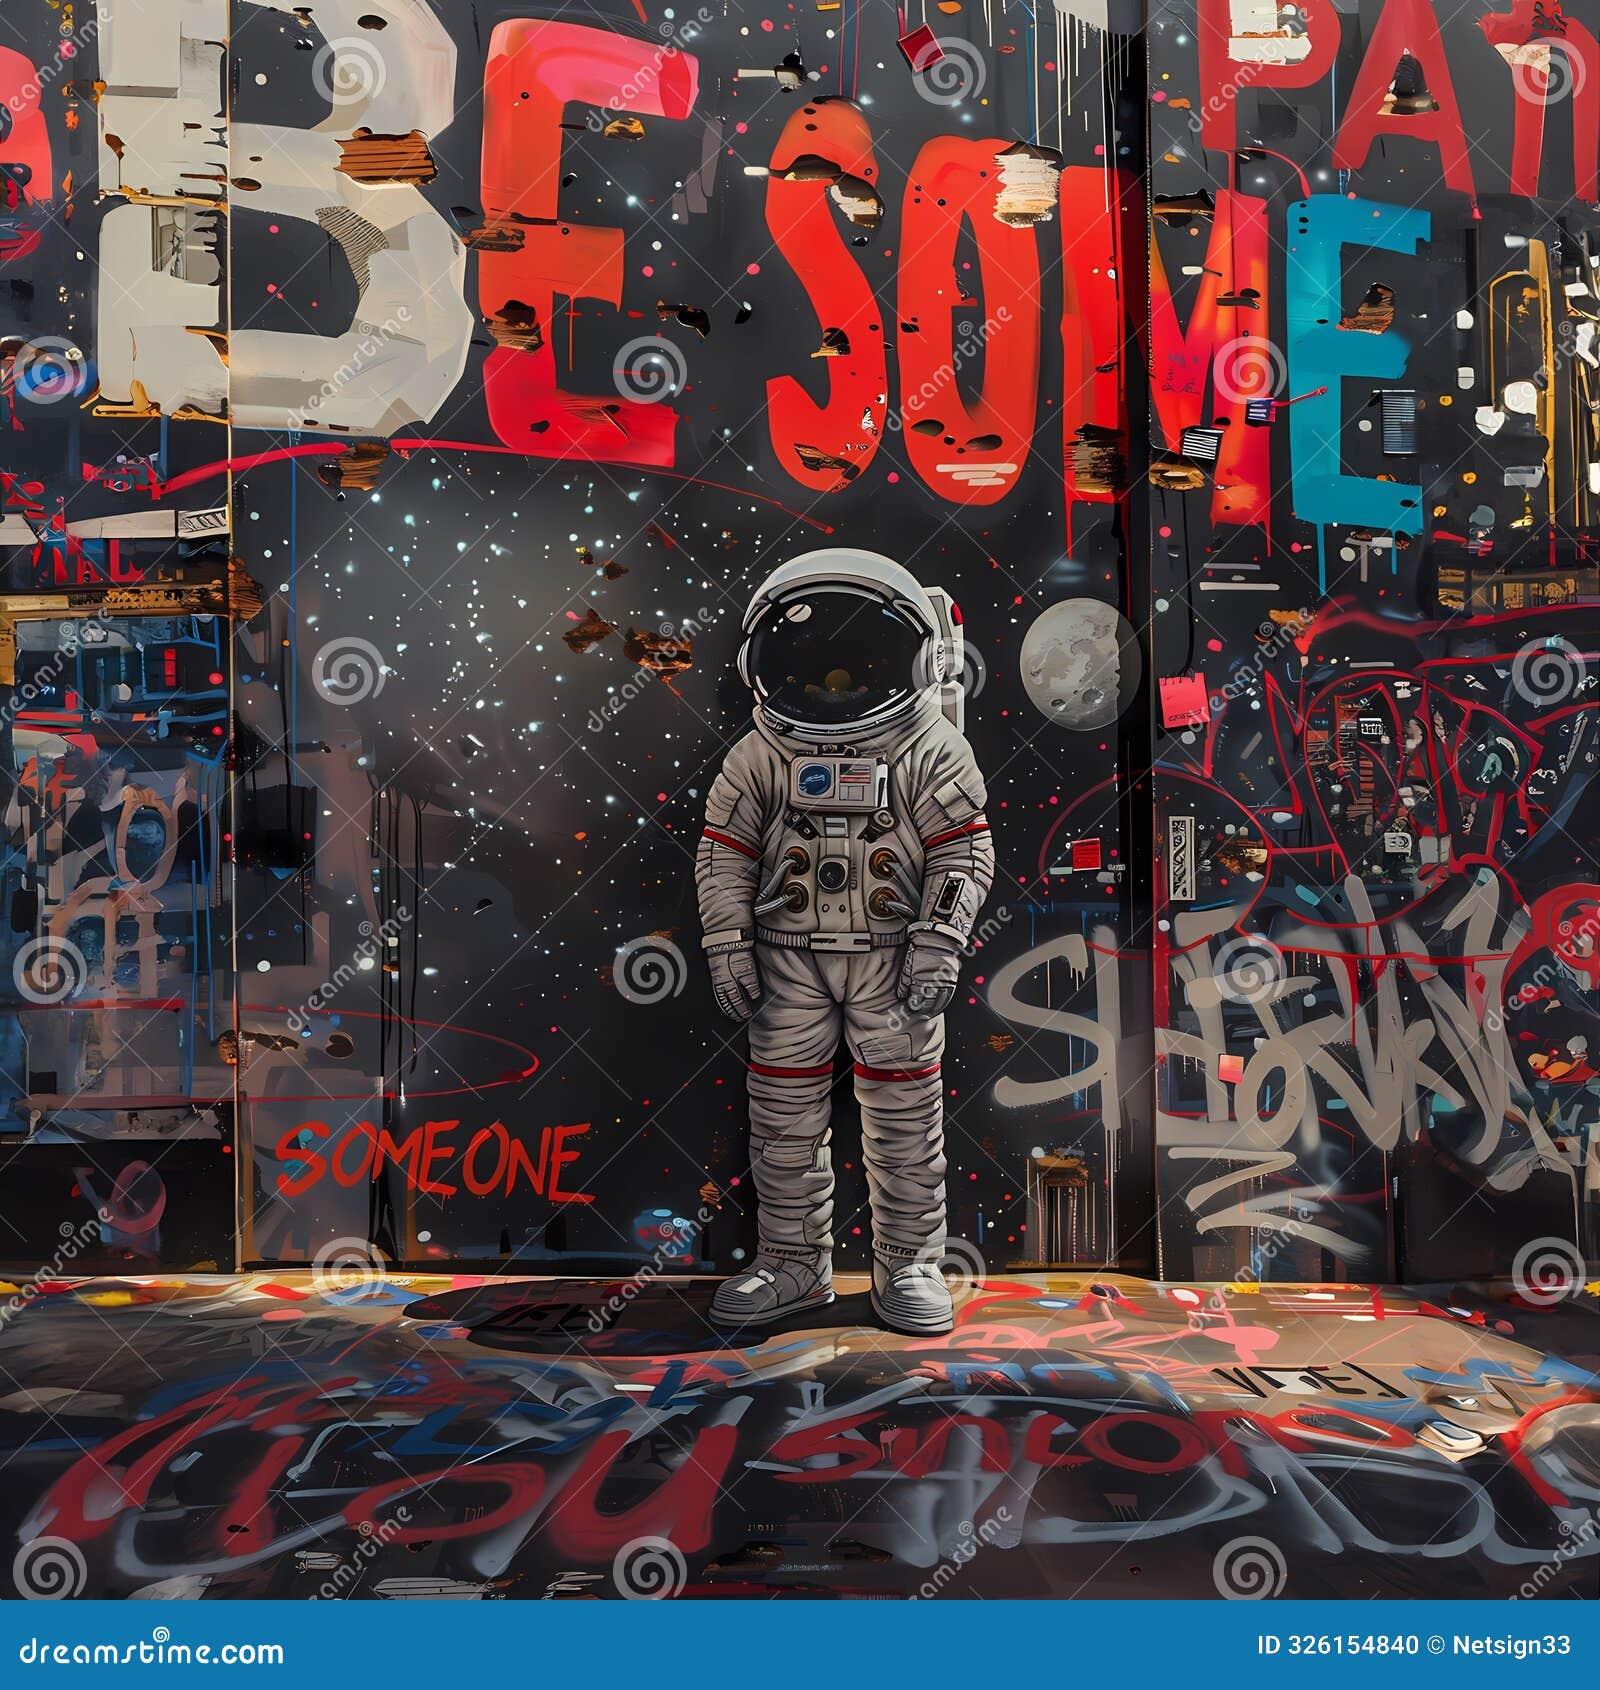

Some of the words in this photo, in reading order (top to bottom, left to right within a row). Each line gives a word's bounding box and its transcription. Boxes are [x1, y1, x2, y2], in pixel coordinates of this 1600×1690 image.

[95, 0, 699, 468] BE
[766, 97, 1432, 535] SOME
[275, 1119, 597, 1204] SOMEONE
